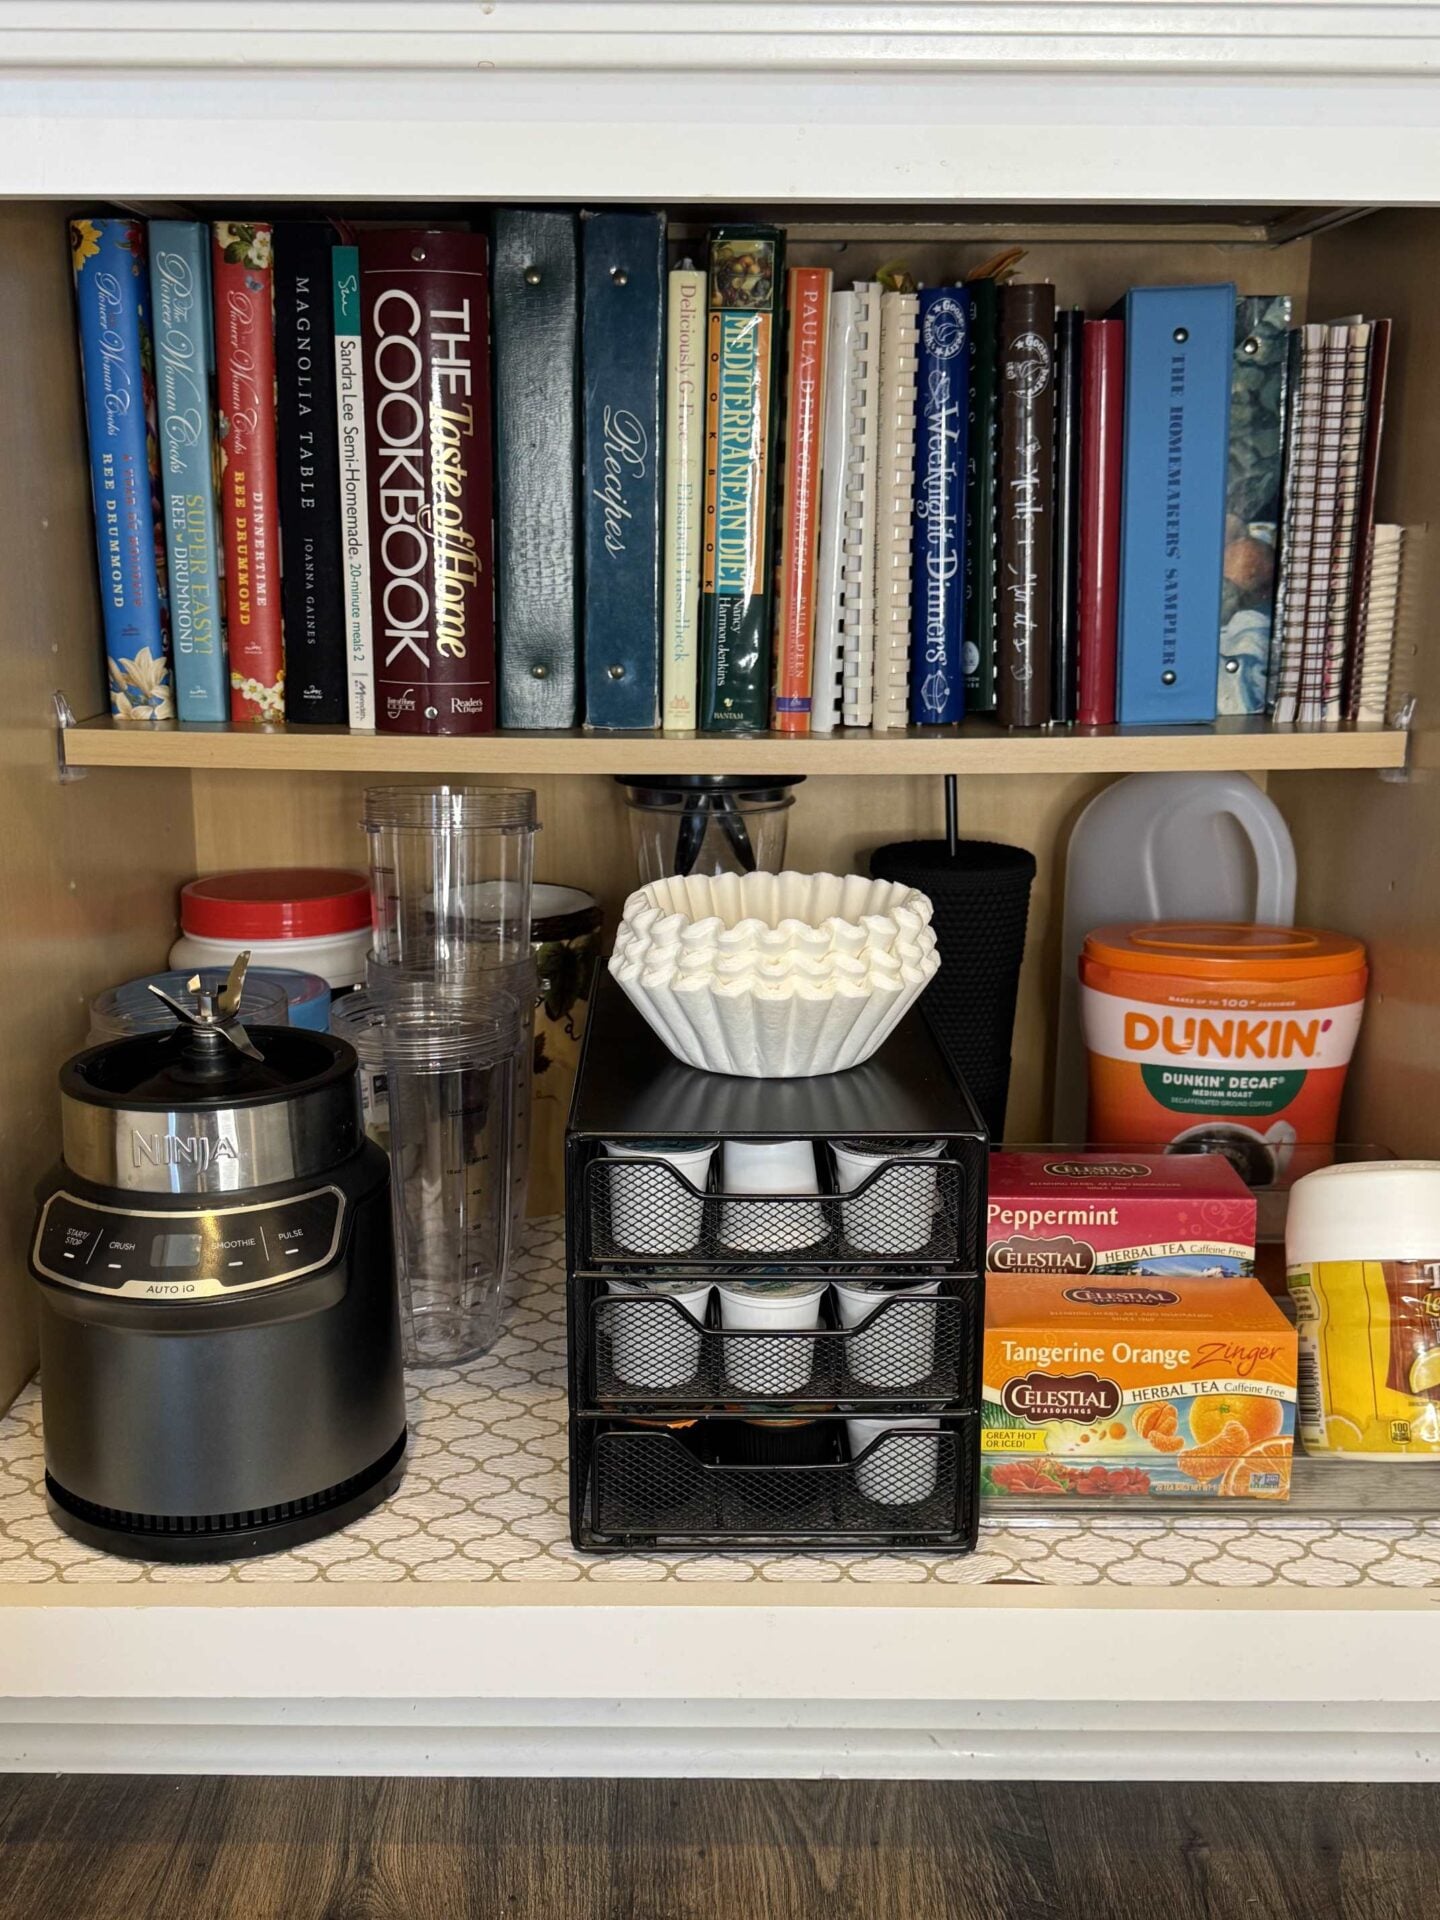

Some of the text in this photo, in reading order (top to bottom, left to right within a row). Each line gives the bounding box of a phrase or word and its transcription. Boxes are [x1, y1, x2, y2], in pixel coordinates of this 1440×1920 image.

[95, 272, 122, 330] Pioneer
[156, 251, 193, 330] Pioneer
[227, 290, 254, 349] Pioneer
[675, 284, 697, 377] Deliciously
[801, 291, 818, 369] PAULA
[99, 330, 130, 390] Woman
[160, 330, 201, 412] Woman
[340, 340, 356, 391] Sandra
[430, 299, 471, 396] THE
[229, 349, 259, 411] Woman
[296, 277, 316, 509] MAGNOLIA TABLE
[1171, 353, 1186, 398] THE
[104, 388, 130, 436] Cooks
[232, 407, 258, 455] Cooks
[341, 394, 357, 421] Lee
[719, 315, 755, 530] MEDITERRANEAN
[165, 407, 202, 475] Cooks
[429, 401, 474, 498] Taste
[373, 289, 430, 668] COOKBOOK
[593, 404, 648, 560] Recipes
[102, 453, 124, 608] REE DRUMMOND
[234, 471, 250, 625] REE DRUMMOND
[253, 491, 267, 607] DINNERTIME
[171, 494, 194, 654] REE DRUMMOND
[186, 494, 213, 656] SUPER EASY!
[304, 538, 316, 645] JOANNA GAINES
[350, 563, 362, 618] 20-minute
[434, 548, 482, 659] Home
[1162, 567, 1179, 666] SAMPLER
[352, 620, 364, 653] meals
[717, 597, 731, 687] Harmon Jenkins
[1124, 1012, 1333, 1059] DUNKIN'
[1162, 1072, 1225, 1088] DUNKIN'
[1192, 1089, 1254, 1098] MEDIUM ROAST
[132, 1129, 238, 1175] NINJA
[1052, 1165, 1145, 1174] CELESTIAL
[65, 1236, 83, 1247] STOP
[278, 1229, 304, 1240] PULSE
[987, 1204, 1119, 1231] Peppermint
[108, 1241, 136, 1251] CRUSH
[211, 1238, 257, 1250] SMOOTHIE
[994, 1247, 1087, 1269] CELESTIAL
[1105, 1242, 1247, 1264] HERBAL TEA Caffeine Free
[146, 1284, 195, 1295] AUTO iQ
[1073, 1290, 1171, 1301] CELESTIAL
[1001, 1341, 1282, 1377] Tangerine Orange Zinger
[1011, 1385, 1111, 1410] CELESTIAL
[1031, 1407, 1092, 1415] SEASONINGS
[1132, 1381, 1286, 1402] HERBAL TEA Caffeine Free
[986, 1431, 1037, 1440] GREAT HOT
[986, 1440, 1026, 1448] OR ICED!
[1392, 1423, 1408, 1433] 100
